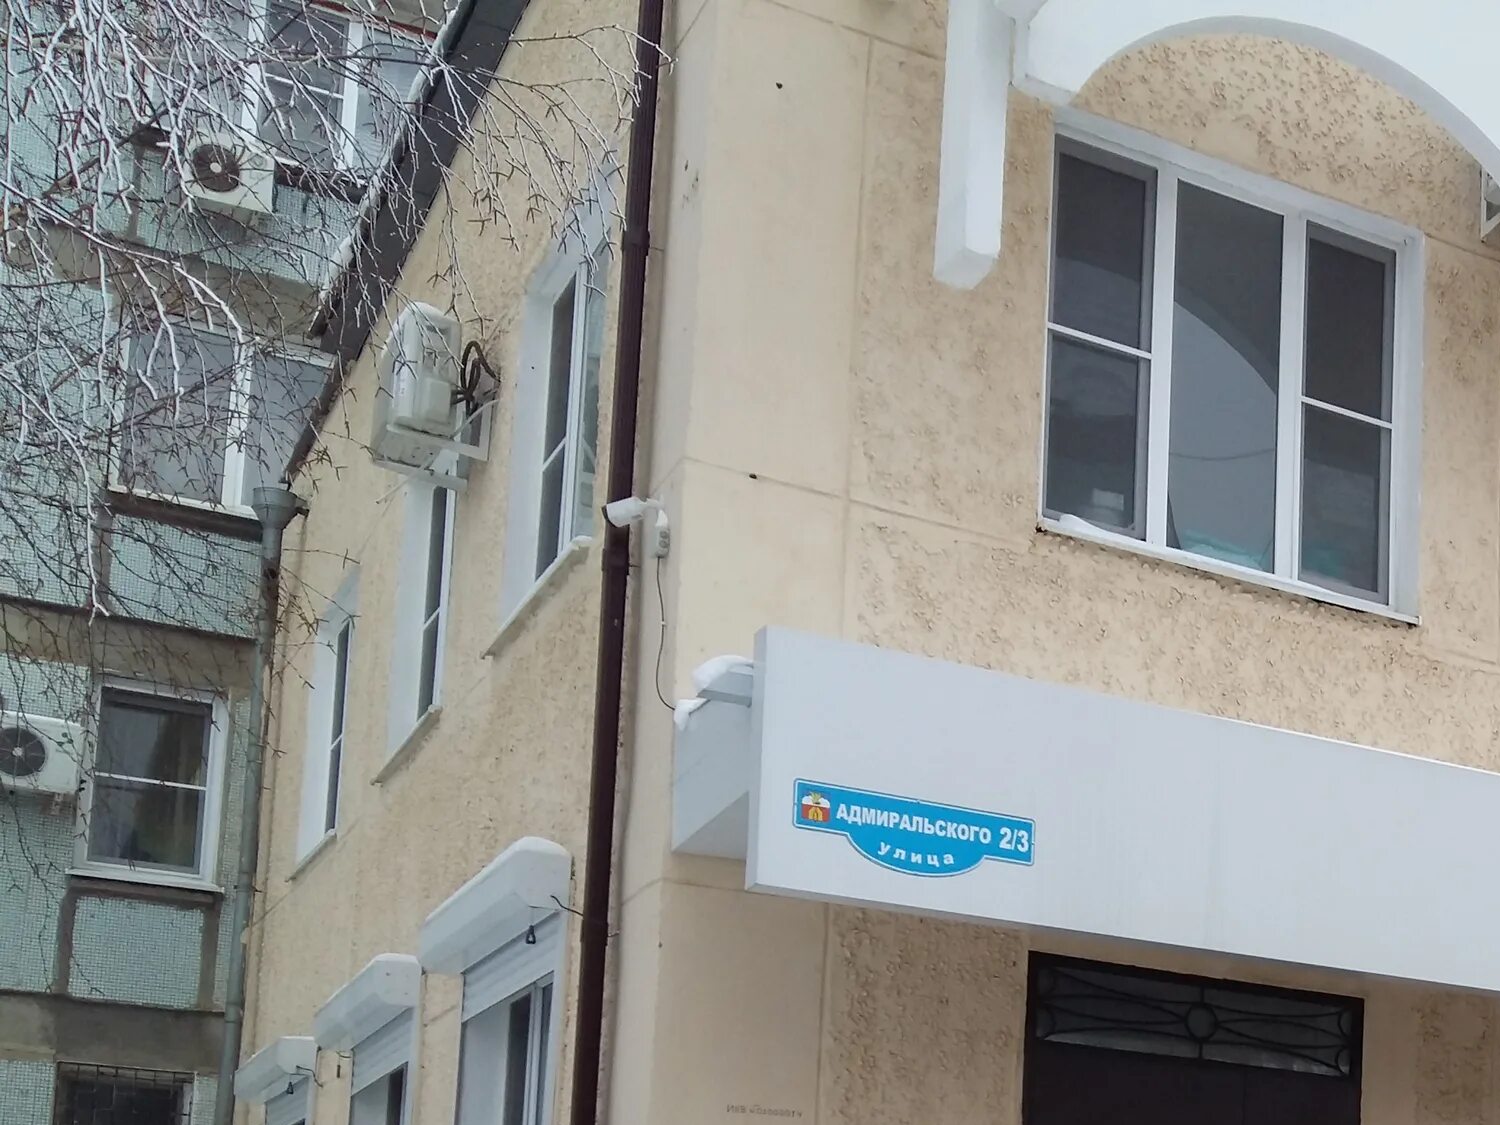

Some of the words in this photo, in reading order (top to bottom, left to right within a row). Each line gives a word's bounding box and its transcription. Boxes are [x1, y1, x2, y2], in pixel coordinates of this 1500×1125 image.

[836, 803, 992, 844] АДМИРАЛЬСКОГО
[999, 826, 1030, 852] 2/3
[877, 842, 955, 867] улица
